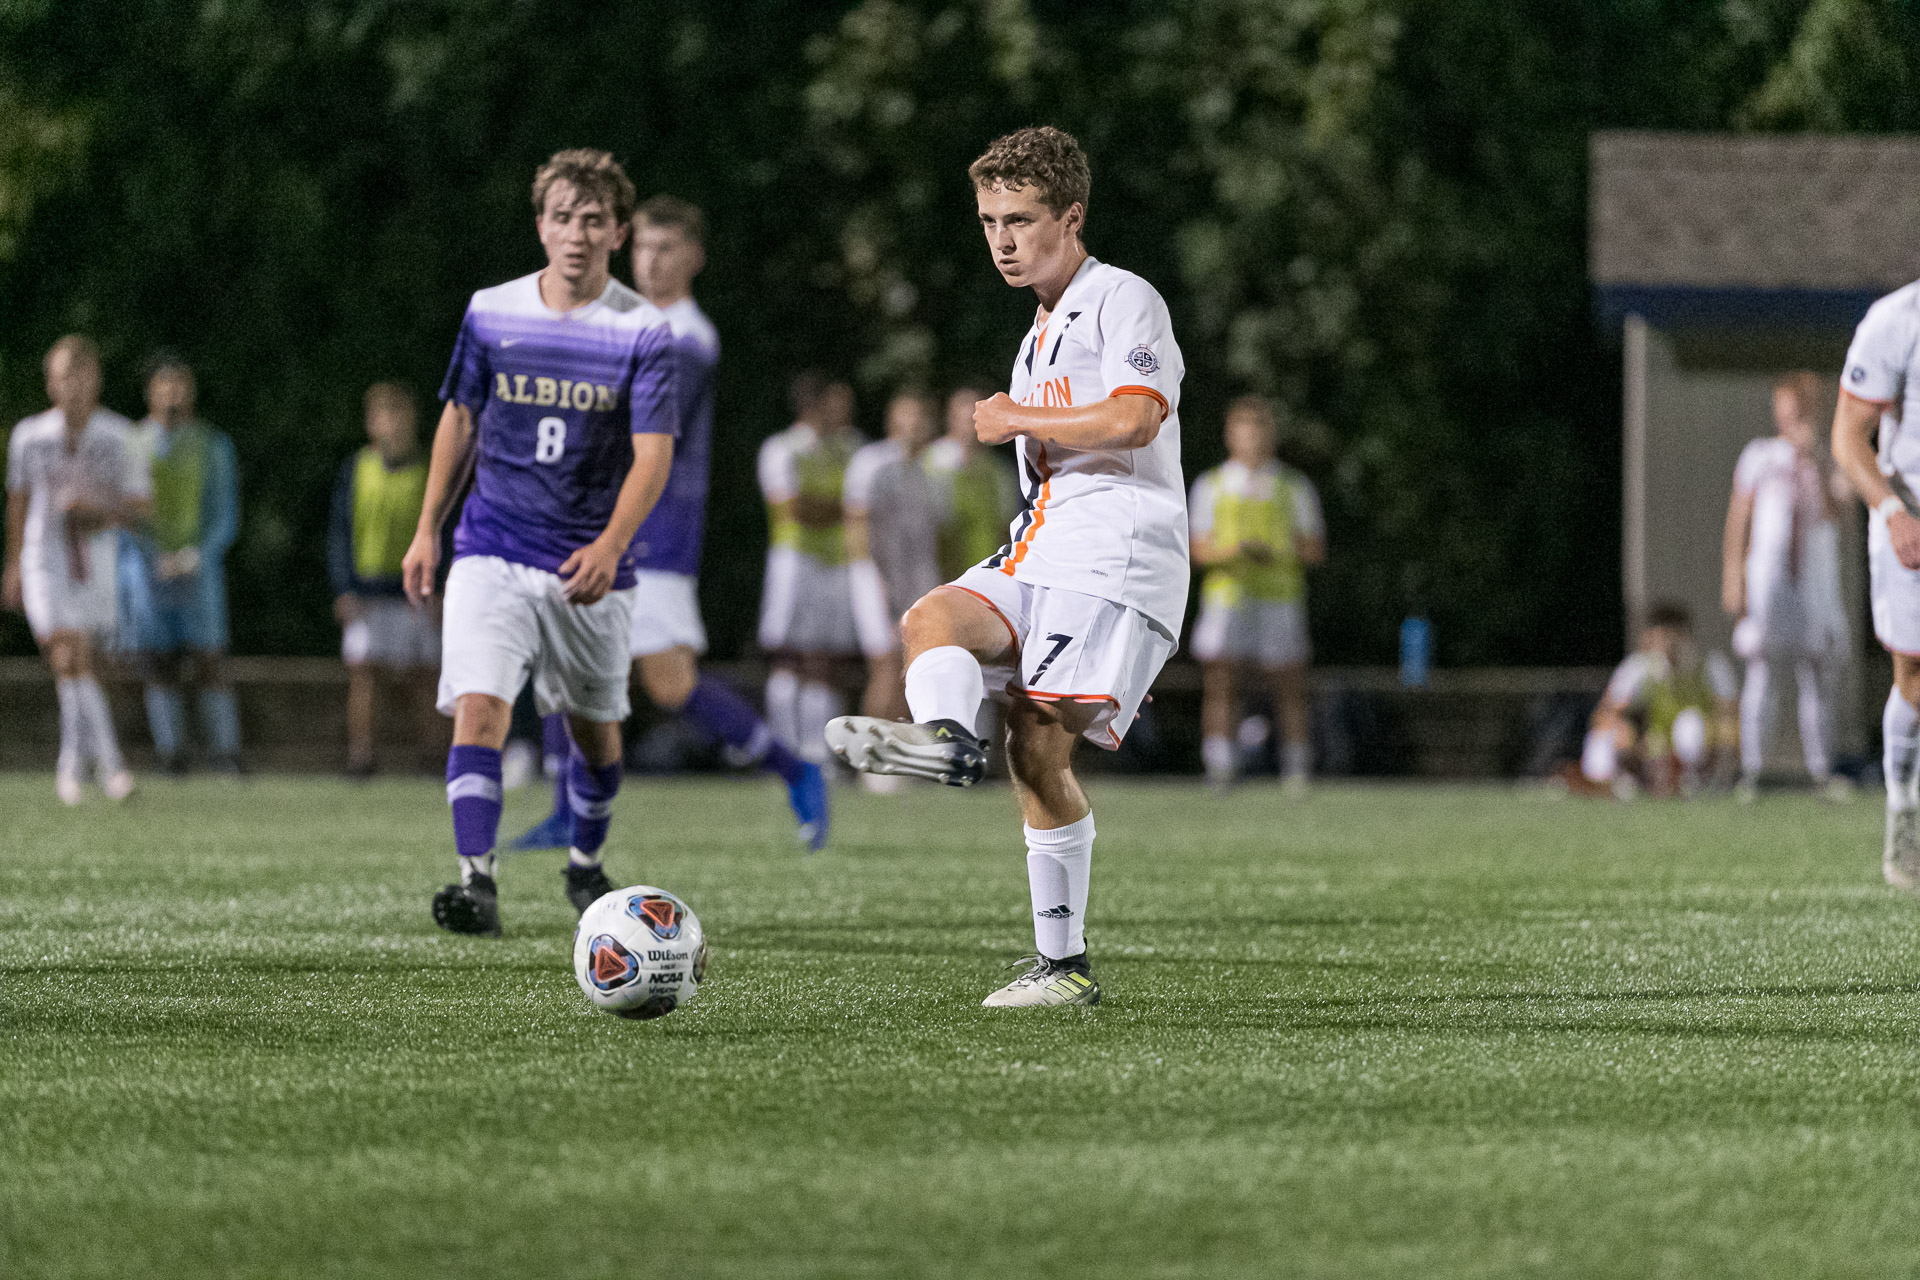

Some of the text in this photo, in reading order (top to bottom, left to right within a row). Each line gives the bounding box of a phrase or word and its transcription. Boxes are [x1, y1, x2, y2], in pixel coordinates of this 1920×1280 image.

[495, 372, 617, 412] ALBION
[535, 416, 567, 465] 8
[1027, 632, 1074, 686] 7
[1037, 911, 1075, 919] adidas
[647, 949, 689, 961] Wilson
[649, 971, 684, 984] NCAA
